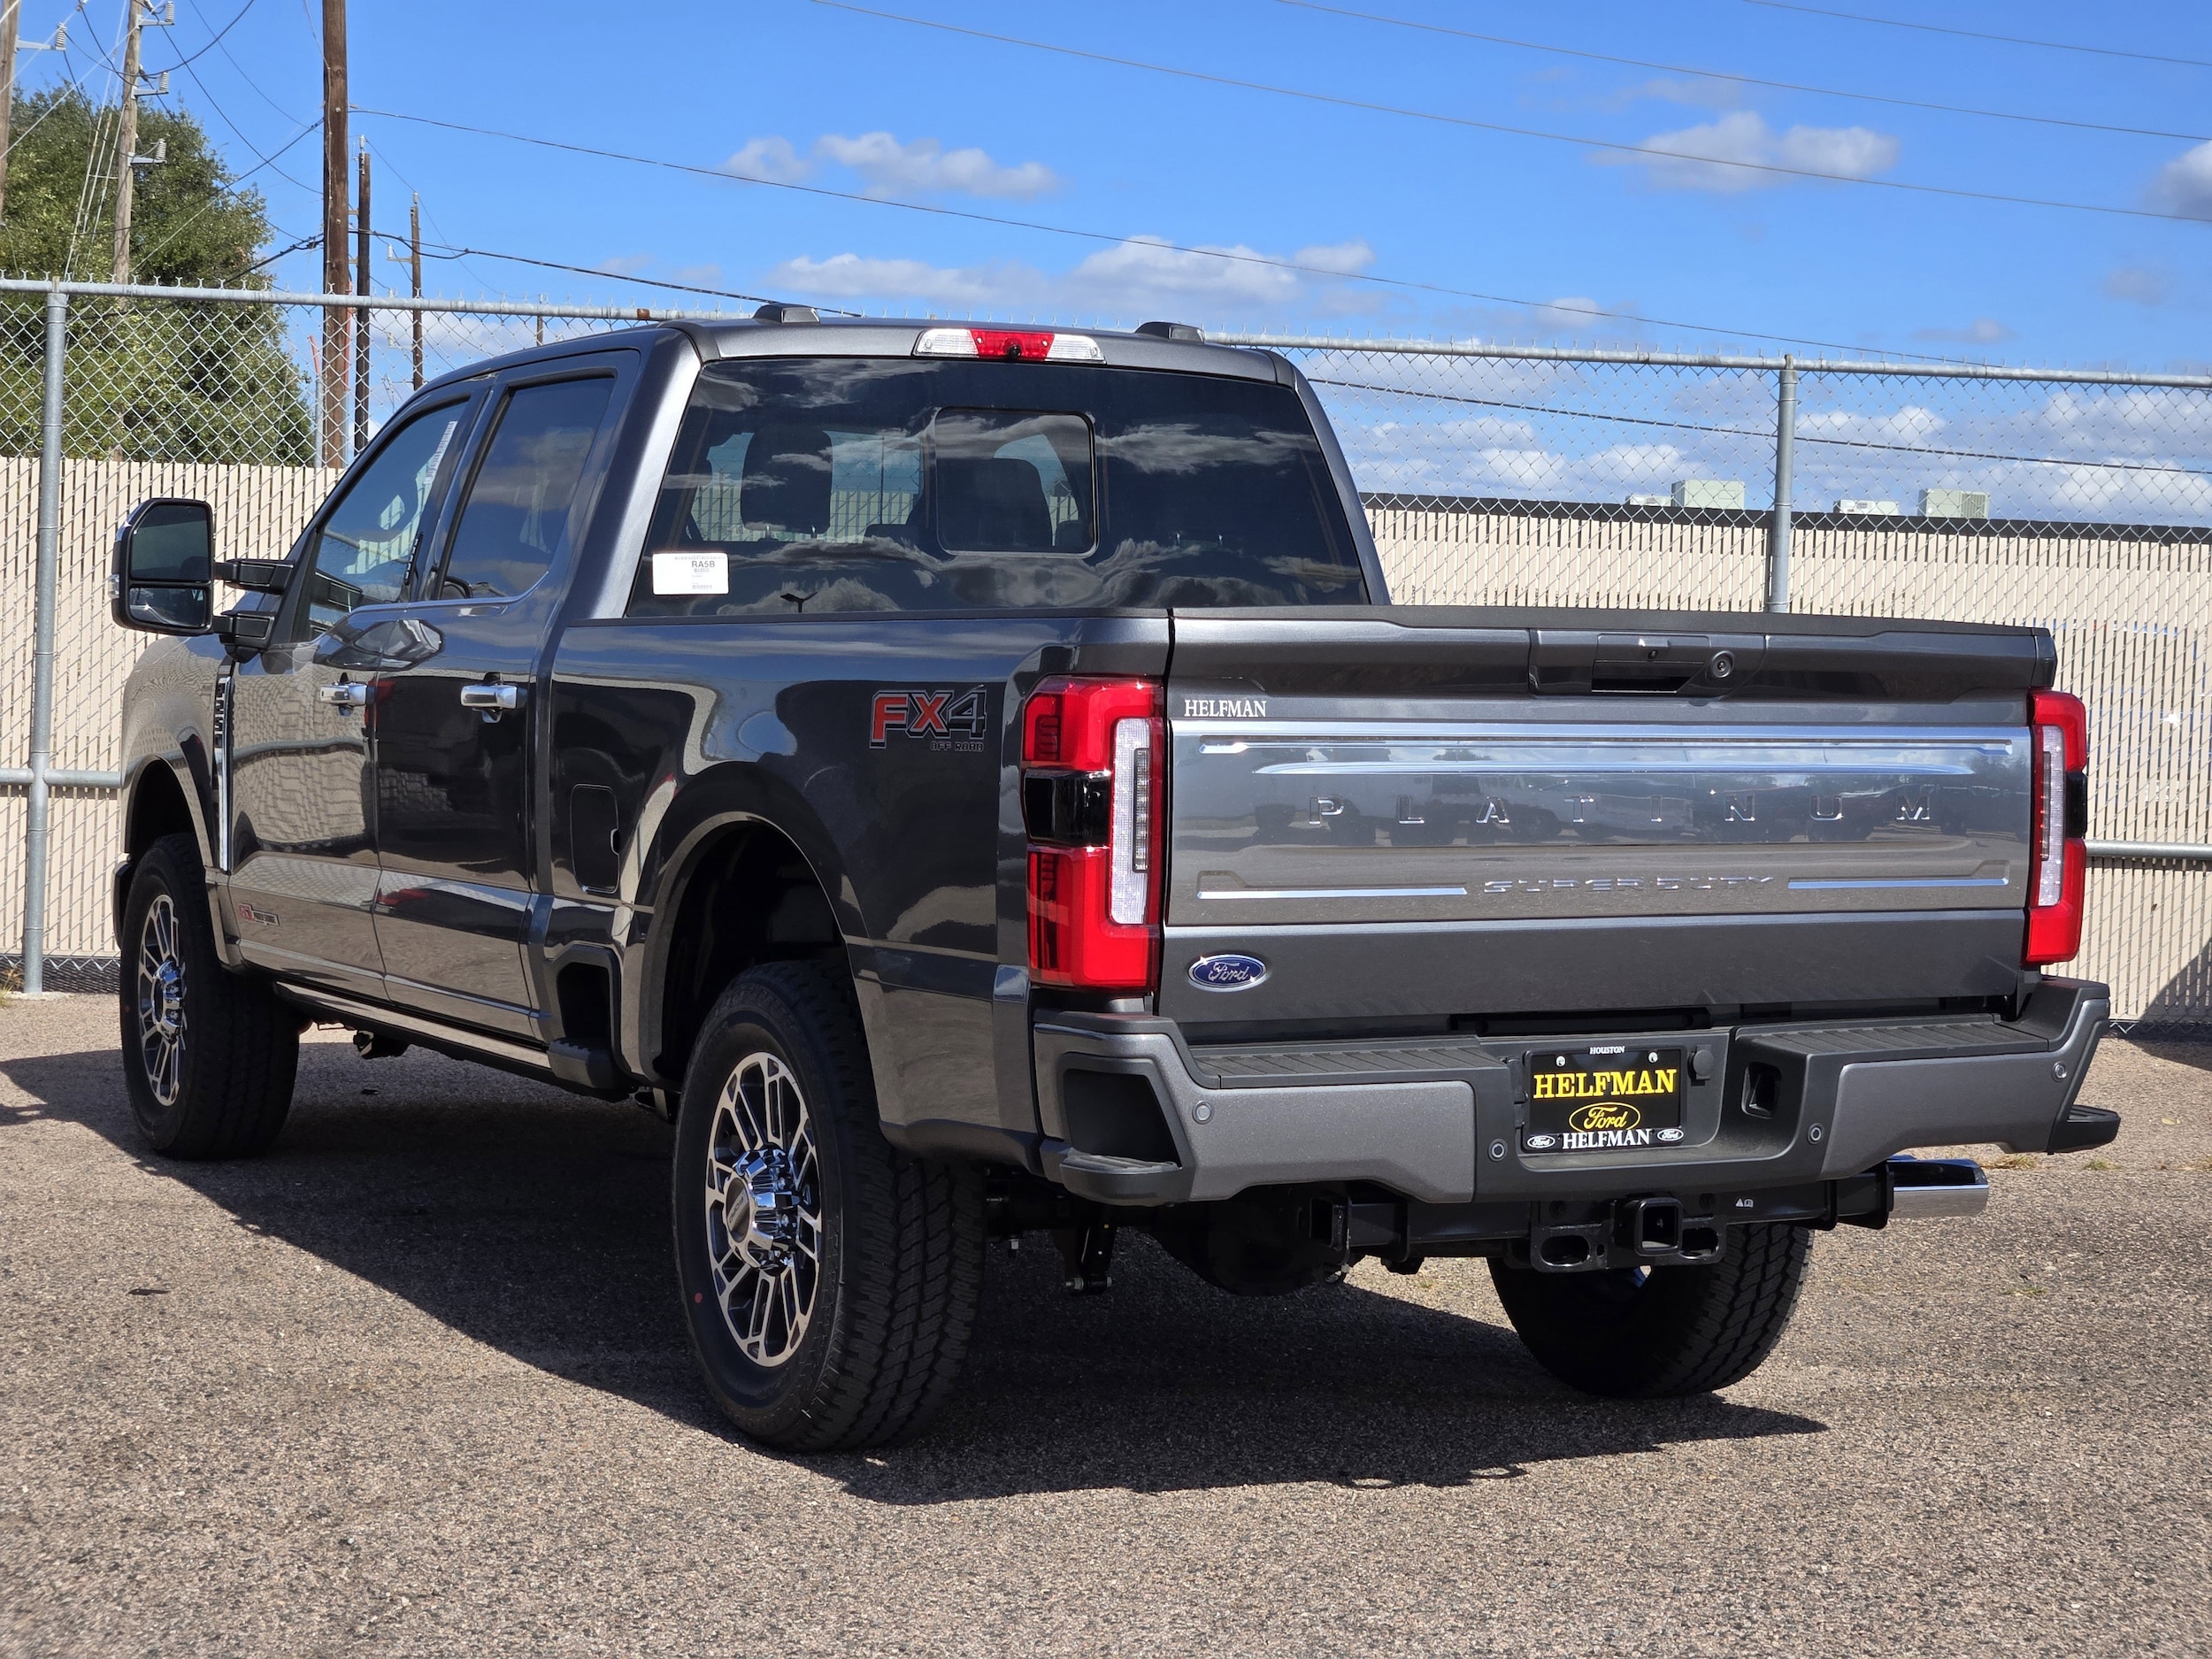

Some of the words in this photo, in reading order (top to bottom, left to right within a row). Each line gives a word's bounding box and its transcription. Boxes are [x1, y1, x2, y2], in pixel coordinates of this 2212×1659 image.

[869, 689, 987, 749] FX4
[1183, 699, 1267, 718] HELFMAN
[930, 741, 952, 751] OFF
[954, 741, 984, 751] ROAD
[1308, 793, 1931, 826] PLATINUM
[1483, 878, 1644, 893] SUPER
[1656, 876, 1774, 890] DUTY
[1208, 961, 1250, 981] Ford
[1589, 1046, 1625, 1055] HOUSTON
[1532, 1069, 1678, 1100] HELFMAN
[1583, 1106, 1629, 1130] Ford
[1562, 1128, 1654, 1150] HELFMAN
